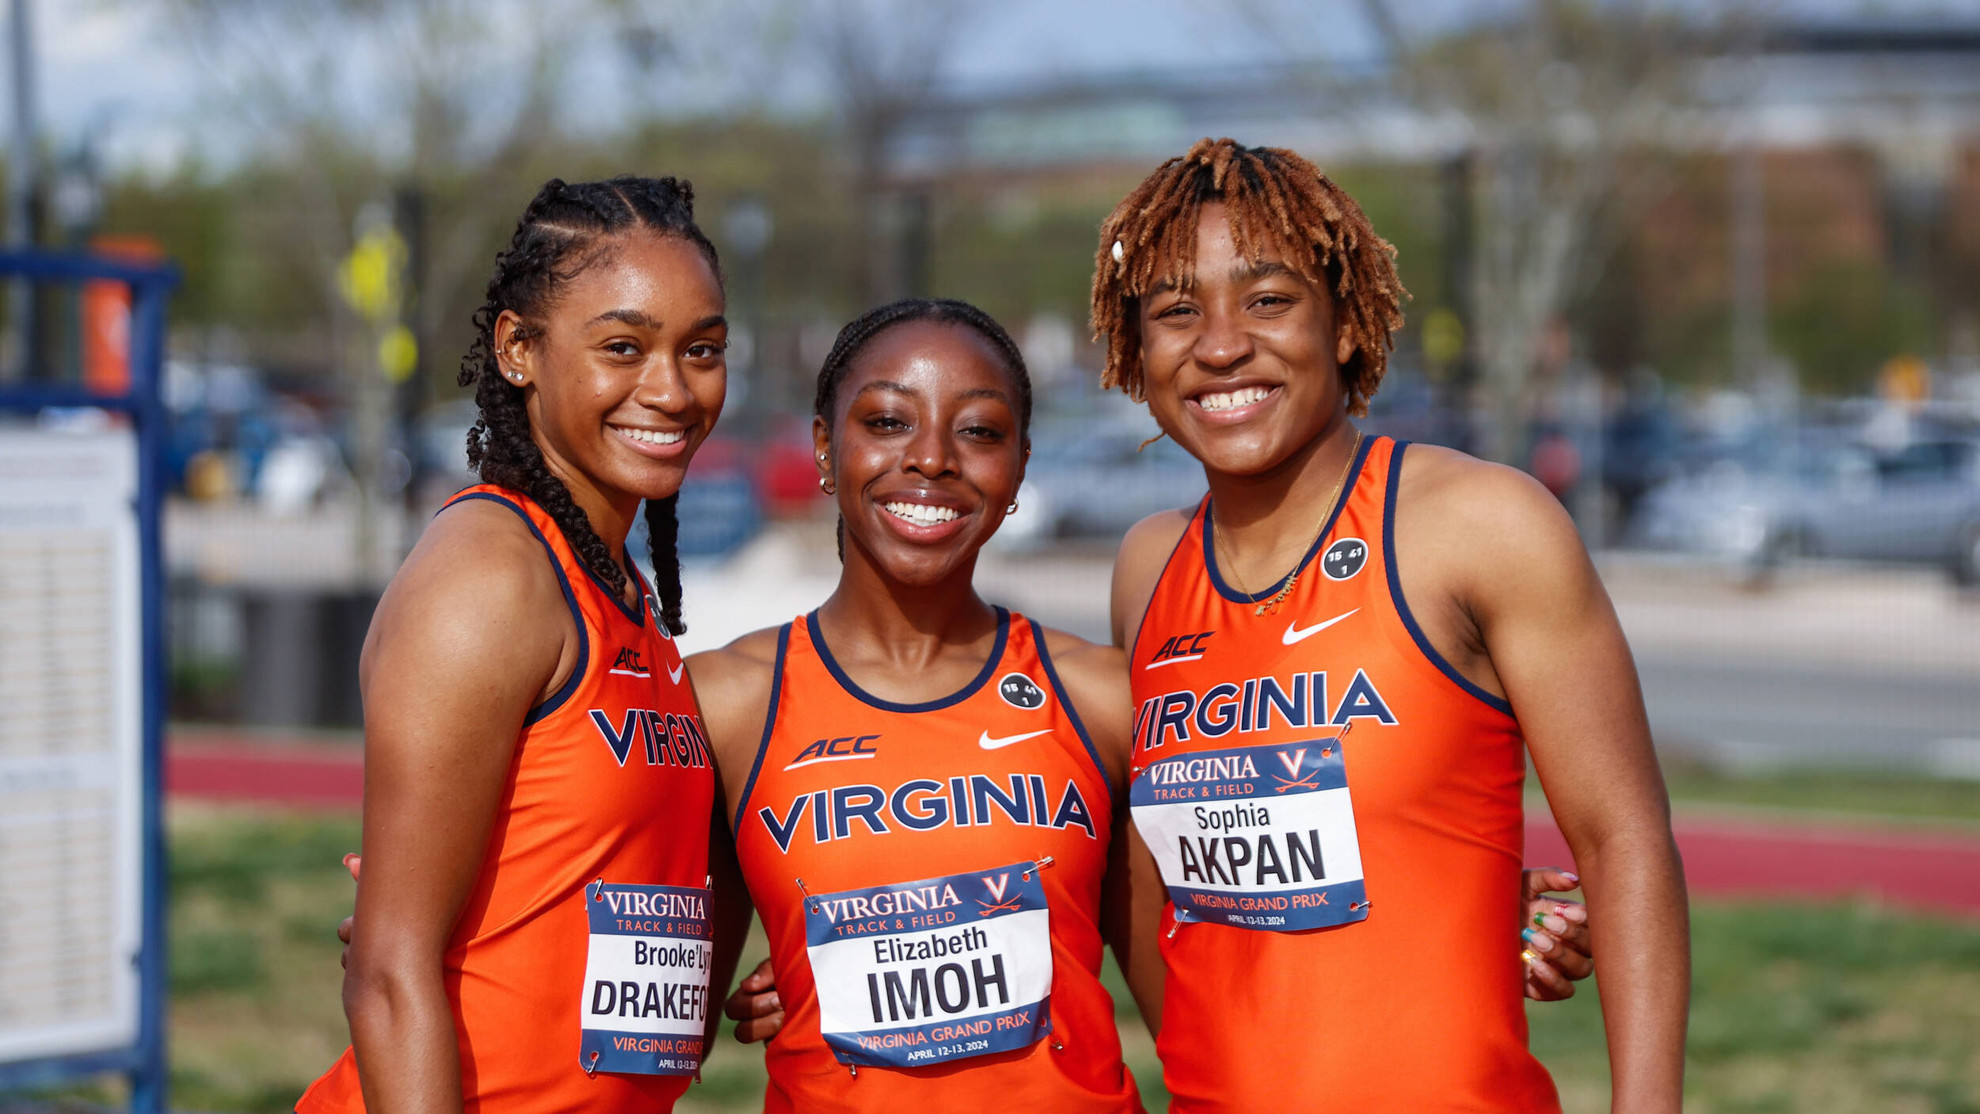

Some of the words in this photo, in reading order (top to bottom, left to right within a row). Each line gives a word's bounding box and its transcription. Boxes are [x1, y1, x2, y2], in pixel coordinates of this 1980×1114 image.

[1327, 550, 1342, 562] 15
[1348, 546, 1362, 558] 41
[1341, 564, 1348, 575] 1
[613, 646, 648, 672] ACC
[1151, 631, 1216, 662] ACC
[1003, 683, 1019, 693] 15
[1022, 697, 1029, 705] 1
[1132, 668, 1399, 759] VIRGINIA
[588, 709, 713, 769] VIRGIN
[792, 734, 883, 763] ACC
[1150, 755, 1260, 786] VIRGINIA
[1154, 787, 1196, 800] TRACK
[1202, 786, 1210, 797] &
[1216, 783, 1254, 797] FIELD
[758, 773, 1097, 855] VIRGINIA
[1194, 803, 1270, 834] Sophia
[1178, 829, 1326, 886] AKPAN
[604, 891, 706, 919] VIRGINIA
[820, 883, 962, 924] VIRGINIA
[1190, 893, 1237, 910] VIRGINIA
[1239, 895, 1288, 911] GRAND
[1292, 892, 1329, 908] PRIX
[616, 919, 660, 933] TRACK
[666, 923, 673, 933] &
[678, 923, 702, 935] FIELD
[835, 921, 888, 936] TRACK
[895, 919, 905, 930] &
[912, 911, 956, 928] FIELD
[873, 926, 988, 964] Elizabeth
[591, 980, 709, 1022] DRAKEFO
[867, 953, 1010, 1023] IMOH
[857, 1029, 929, 1050] VIRGINIA
[931, 1020, 993, 1041] GRAND
[996, 1011, 1031, 1031] PRIX
[613, 1036, 674, 1054] VIRGINIA
[907, 1049, 936, 1061] APRIL
[965, 1040, 989, 1051] 2024
[658, 1059, 676, 1069] APRIL
